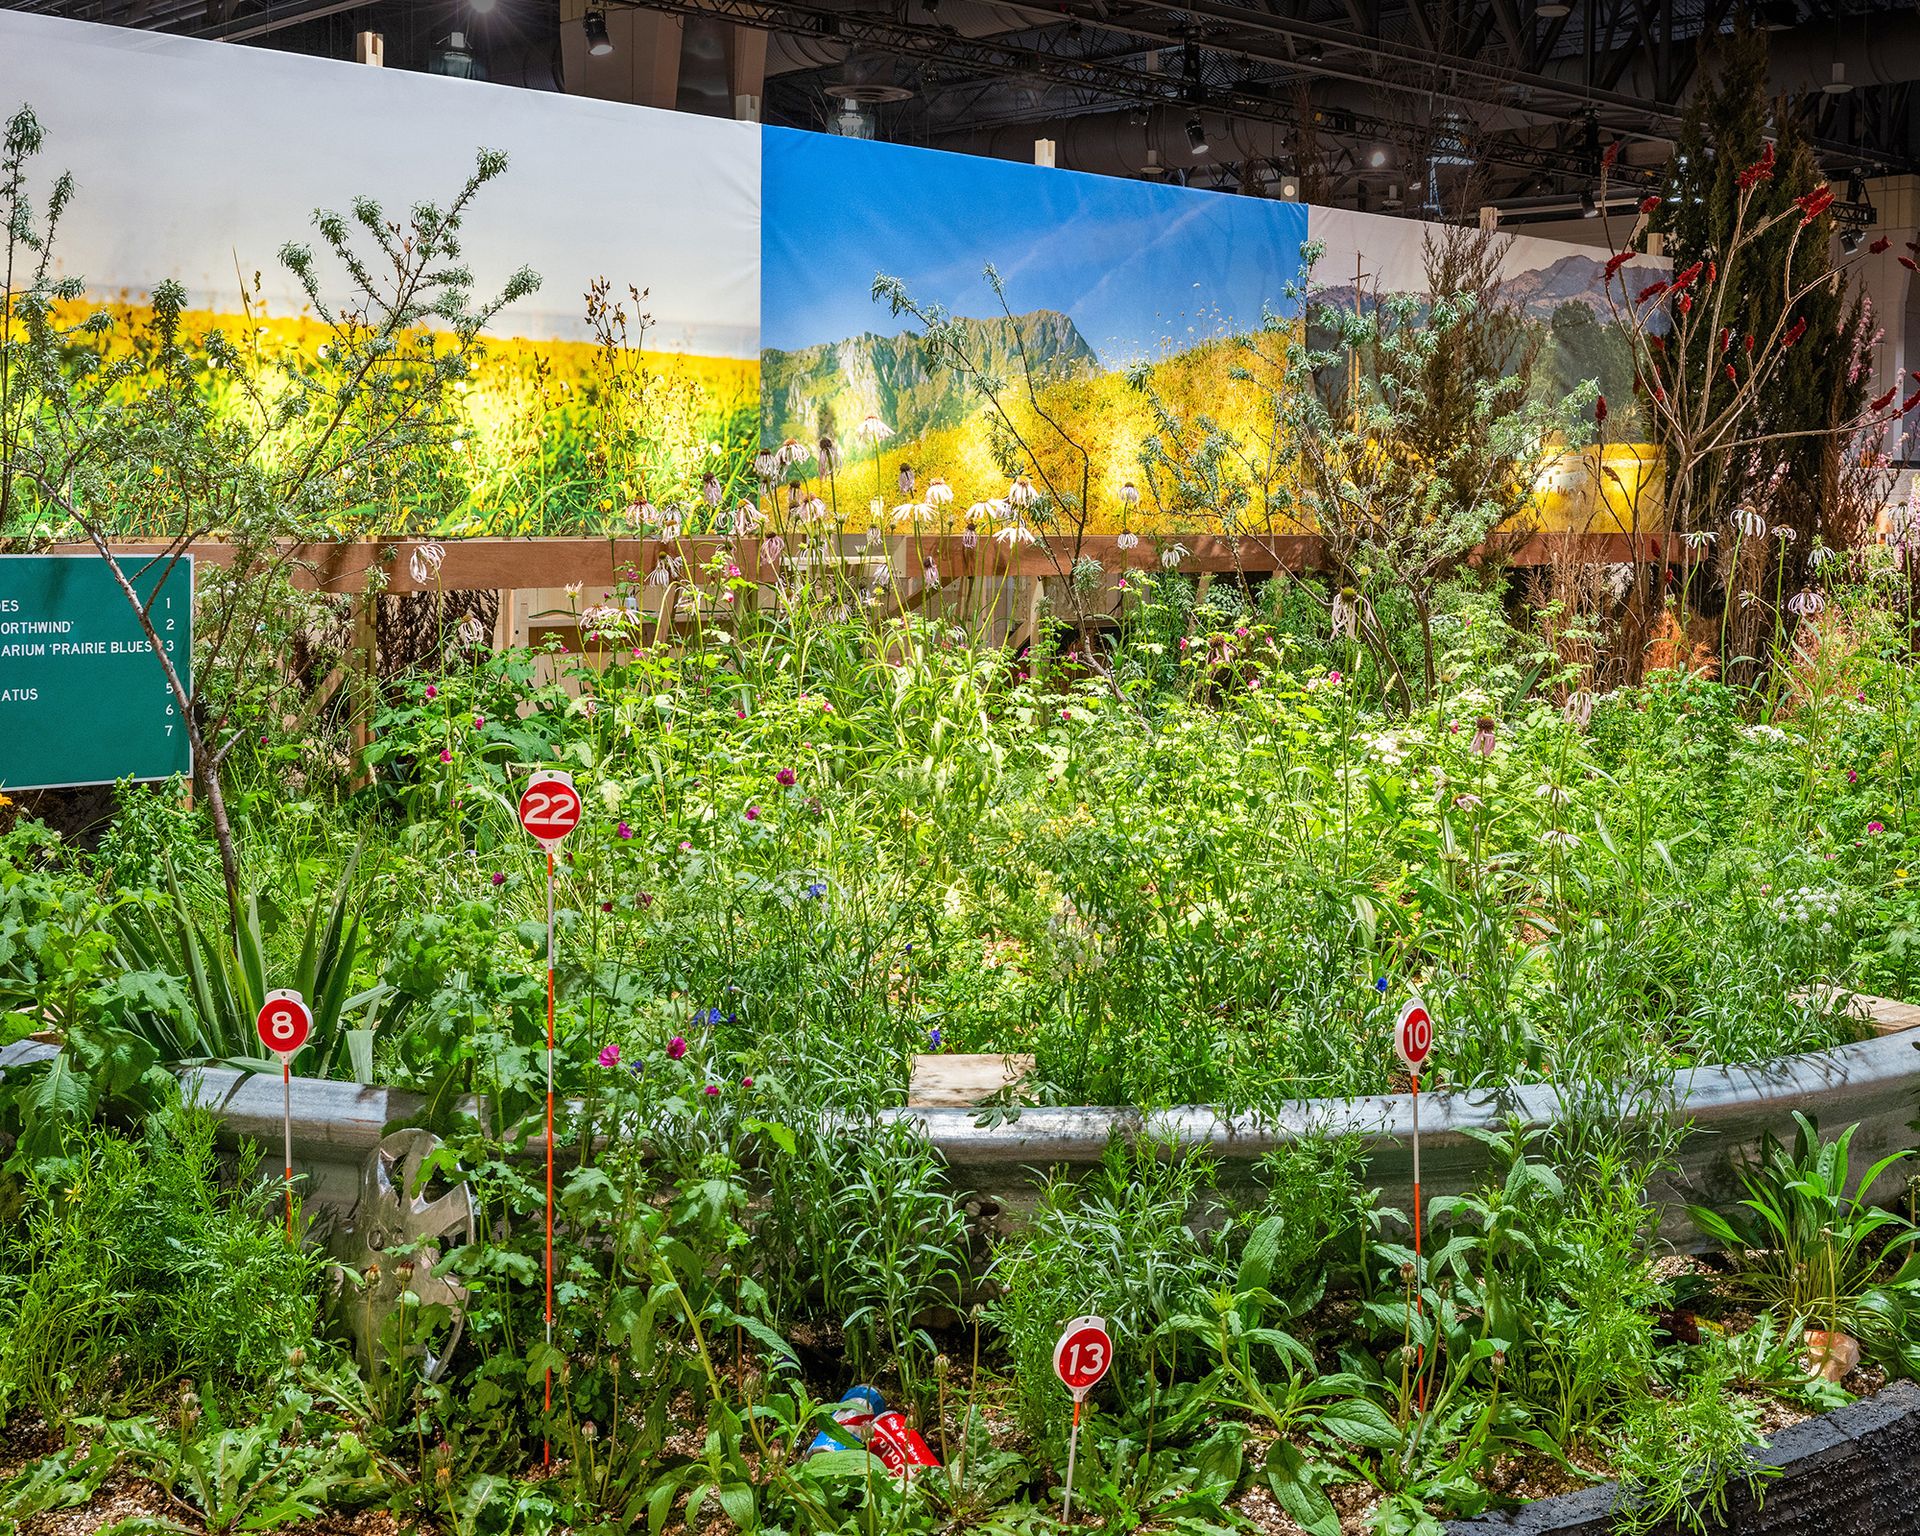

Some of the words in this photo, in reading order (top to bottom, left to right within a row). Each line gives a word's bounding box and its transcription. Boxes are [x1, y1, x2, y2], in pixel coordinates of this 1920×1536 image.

[0, 600, 19, 612] ES
[166, 597, 171, 609] 1
[166, 618, 175, 630] 2
[1, 643, 45, 657] ARIUM
[49, 642, 107, 655] 'PRAIRIE
[166, 640, 174, 652] 3
[1, 688, 38, 701] ATUS
[166, 683, 174, 694] 5
[165, 704, 174, 715] 6
[164, 725, 173, 737] 7
[524, 792, 575, 825] 22
[271, 1011, 295, 1040] 8
[1407, 1020, 1428, 1053] 10
[1069, 1342, 1104, 1376] 13
